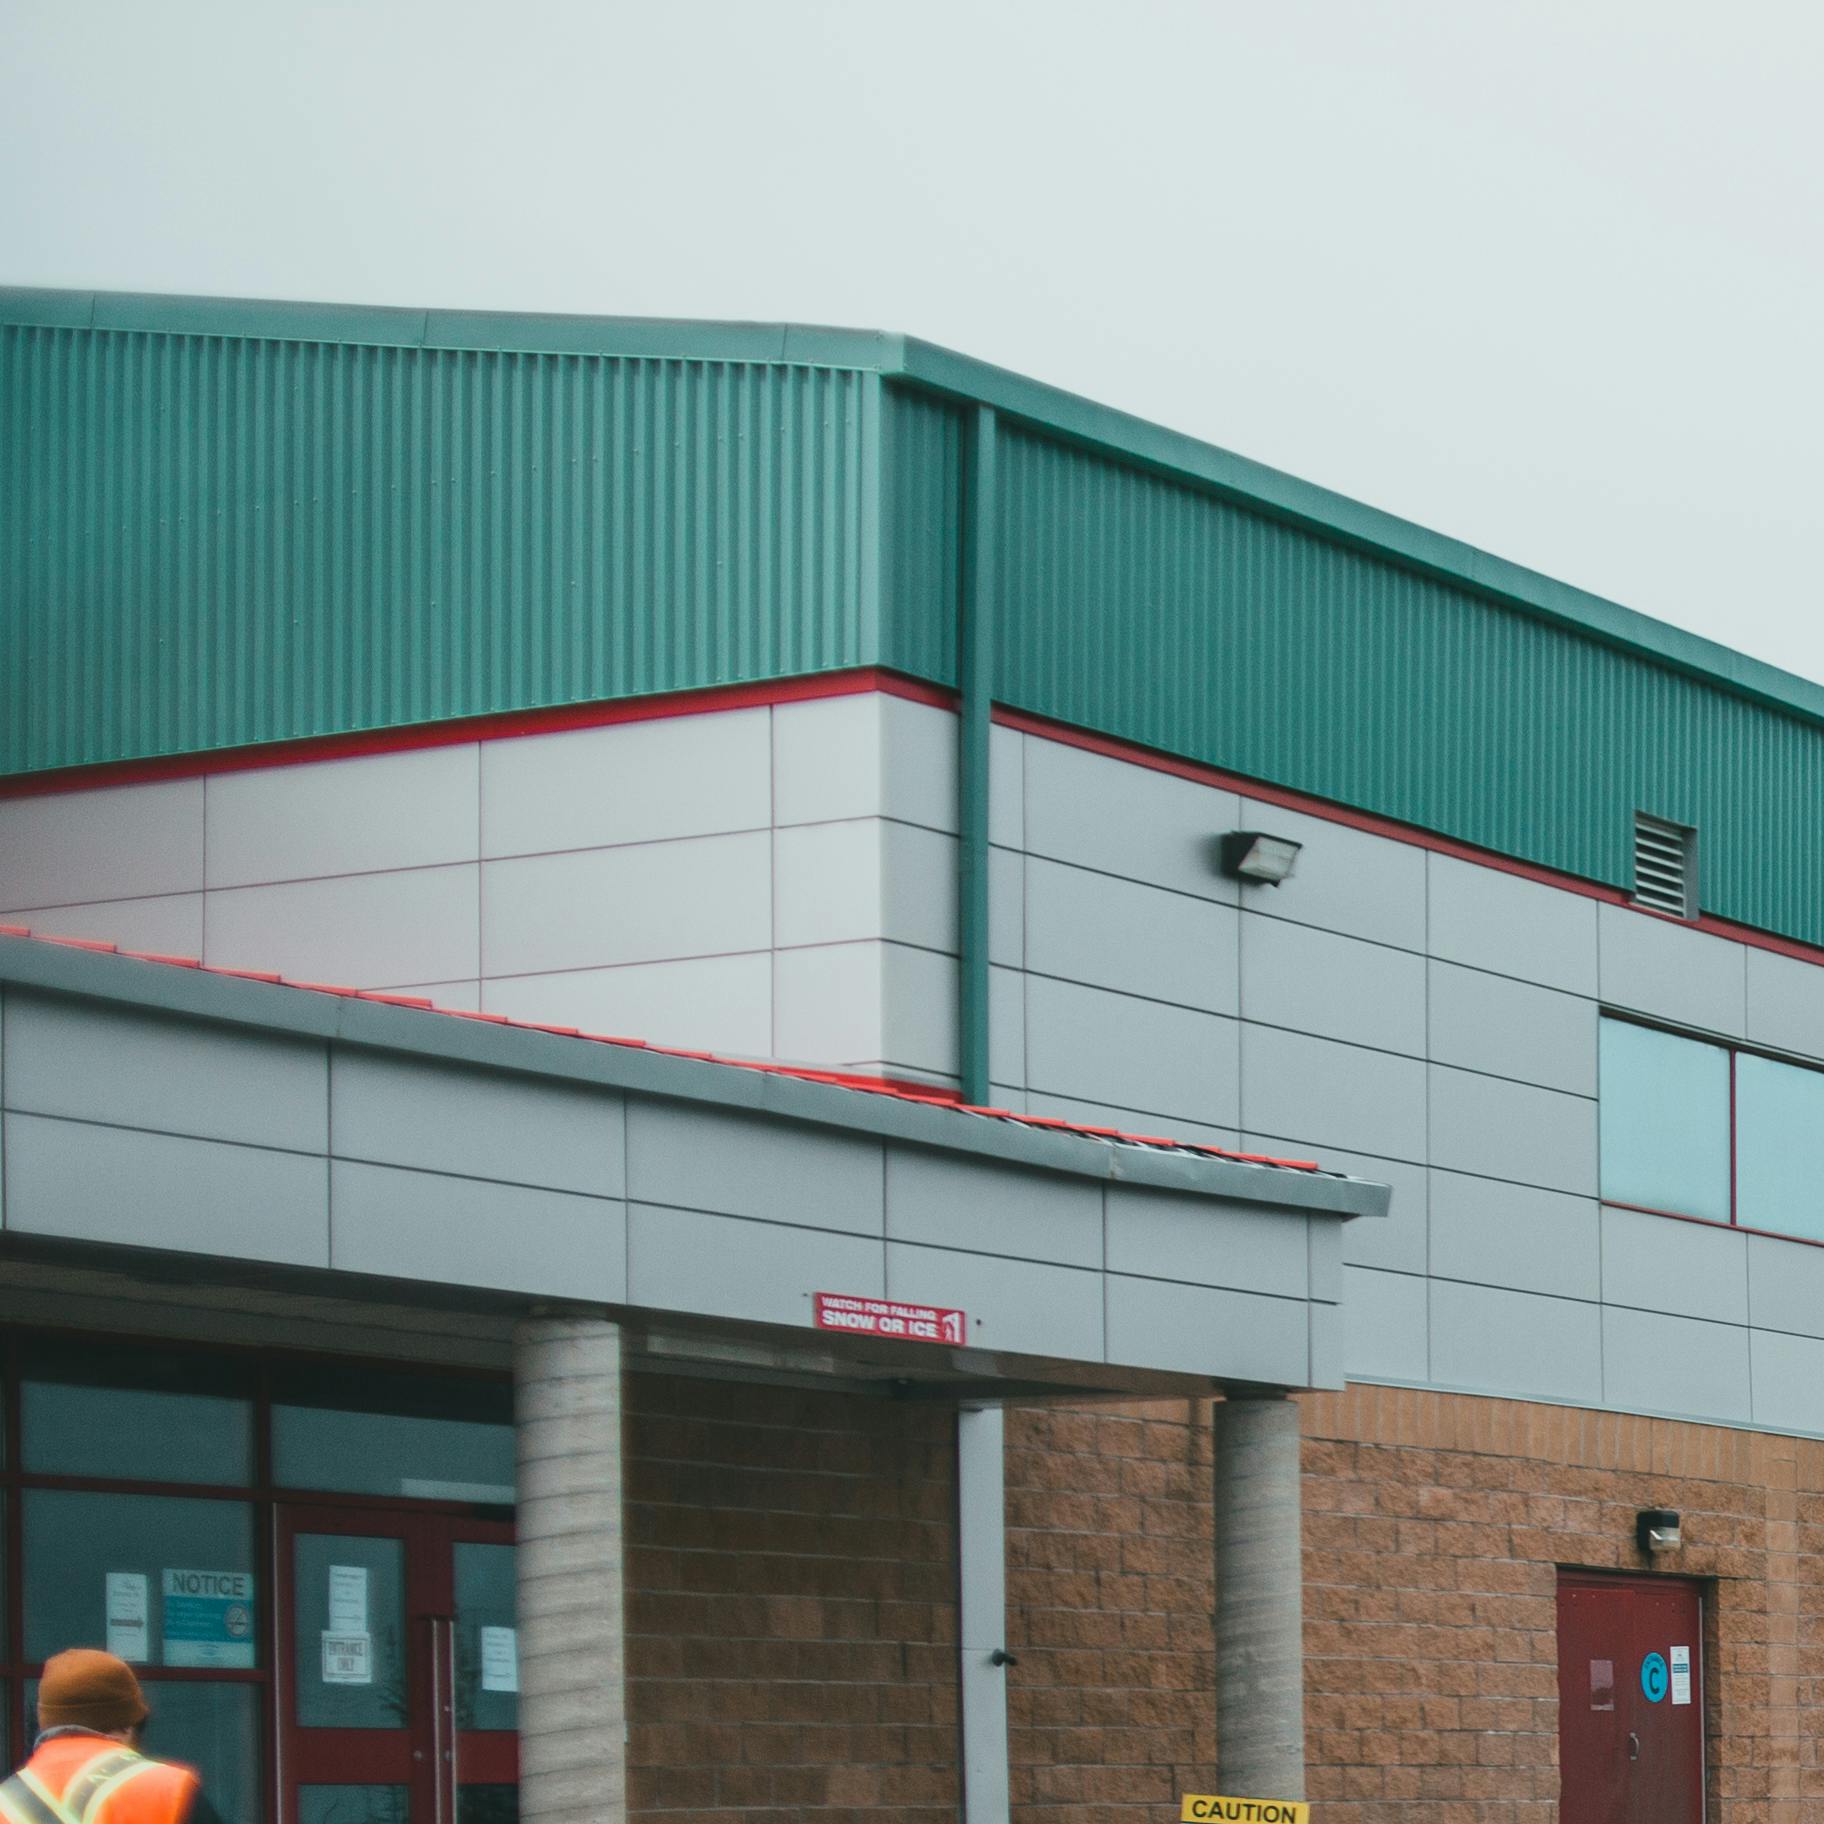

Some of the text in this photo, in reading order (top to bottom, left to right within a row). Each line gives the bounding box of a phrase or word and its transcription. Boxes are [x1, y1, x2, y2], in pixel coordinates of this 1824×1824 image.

[822, 1296, 938, 1320] WATCH FOR FALLING
[822, 1309, 938, 1338] SNOW OR ICE
[172, 1572, 245, 1596] NOTICE
[1649, 1667, 1660, 1695] C
[1191, 1799, 1297, 1824] CAUTION
